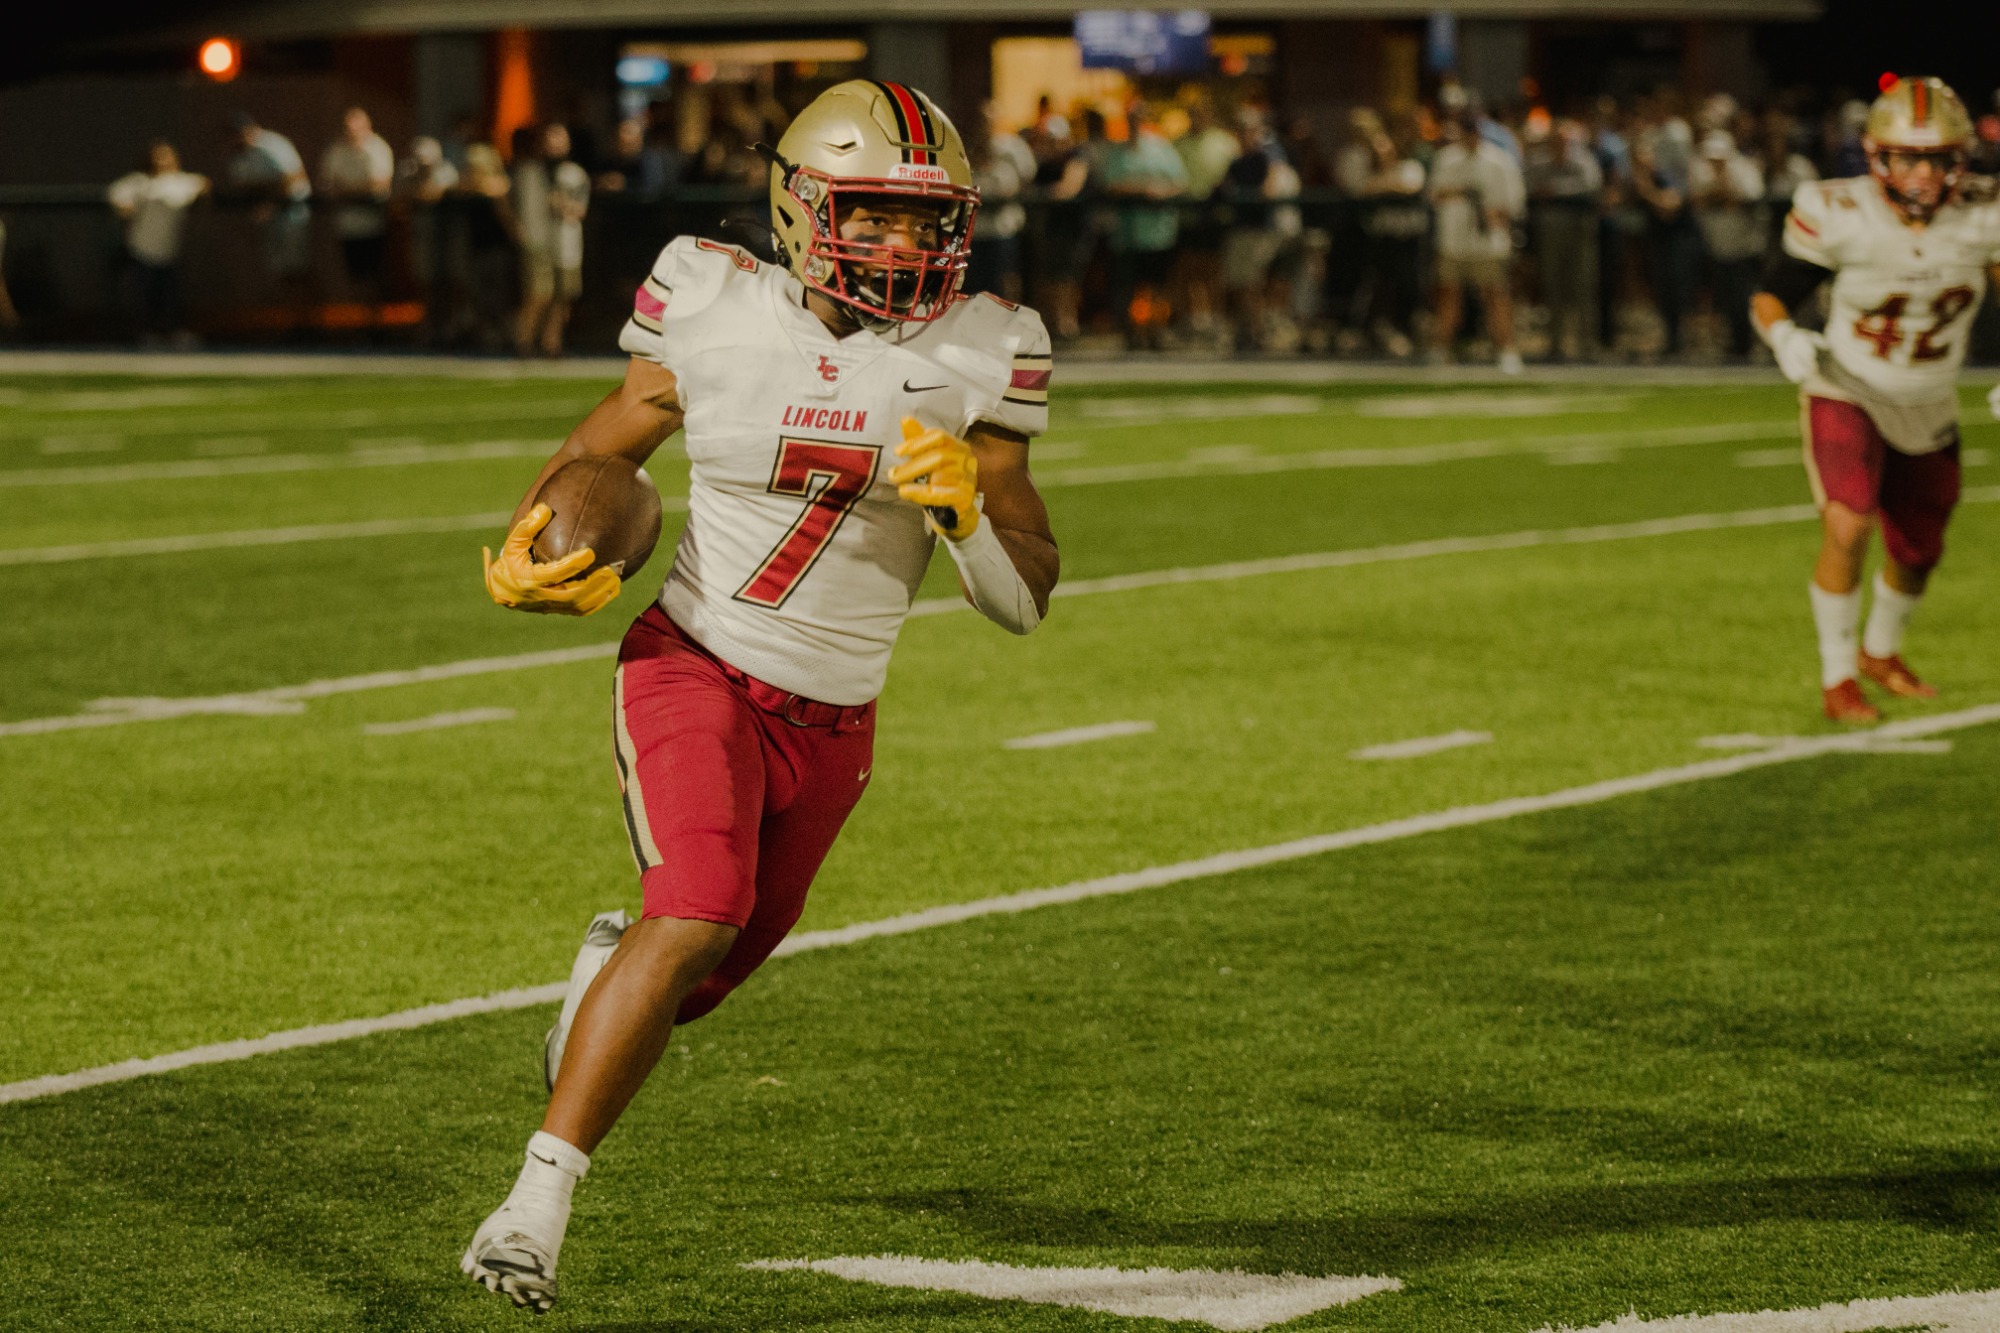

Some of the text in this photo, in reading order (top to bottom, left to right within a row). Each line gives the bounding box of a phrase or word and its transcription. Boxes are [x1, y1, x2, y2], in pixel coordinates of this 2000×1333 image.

[898, 167, 944, 180] Riddell
[1854, 286, 1974, 364] 42
[781, 405, 868, 432] LINCOLN
[731, 435, 884, 610] 7
